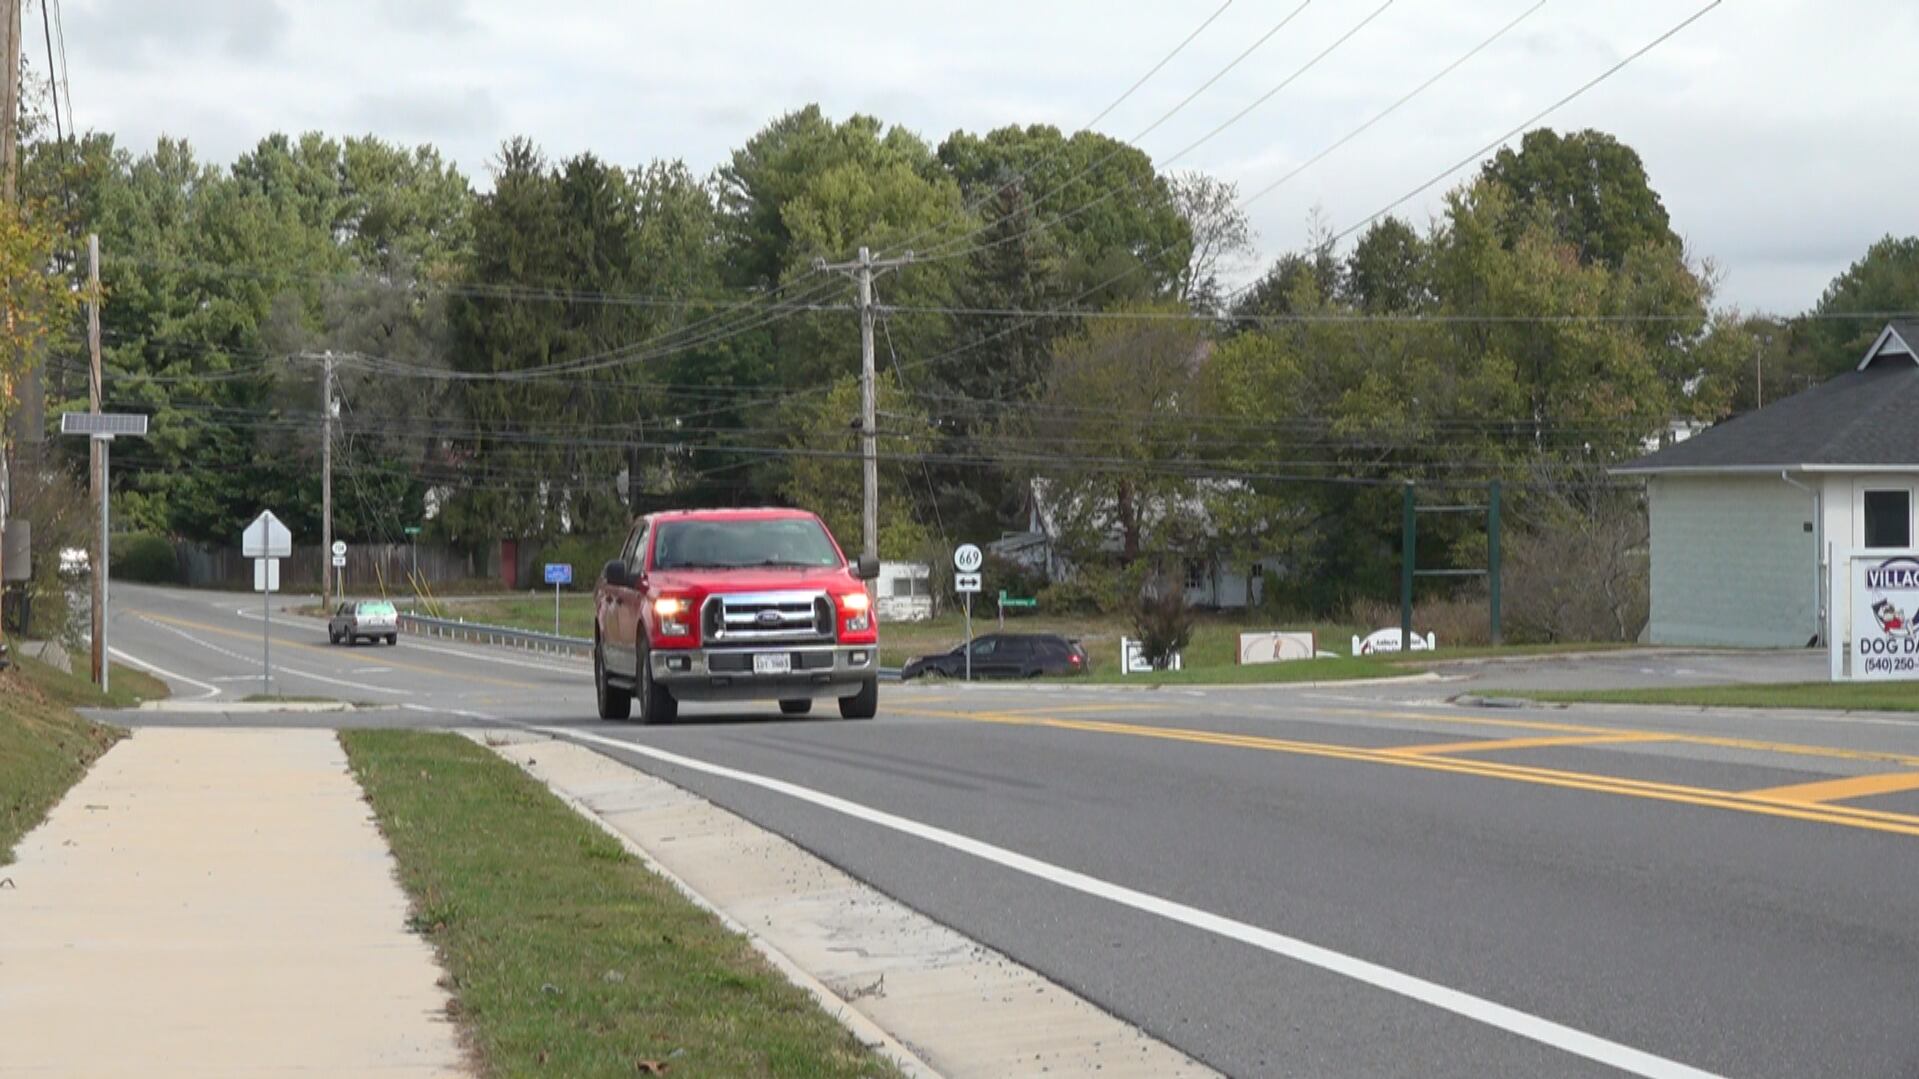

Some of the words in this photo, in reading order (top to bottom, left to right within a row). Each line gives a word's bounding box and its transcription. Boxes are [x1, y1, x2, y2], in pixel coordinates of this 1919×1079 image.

[959, 550, 979, 565] 669
[1860, 638, 1898, 654] DOG
[1864, 657, 1893, 674] (540)
[1894, 657, 1919, 671] 250-
